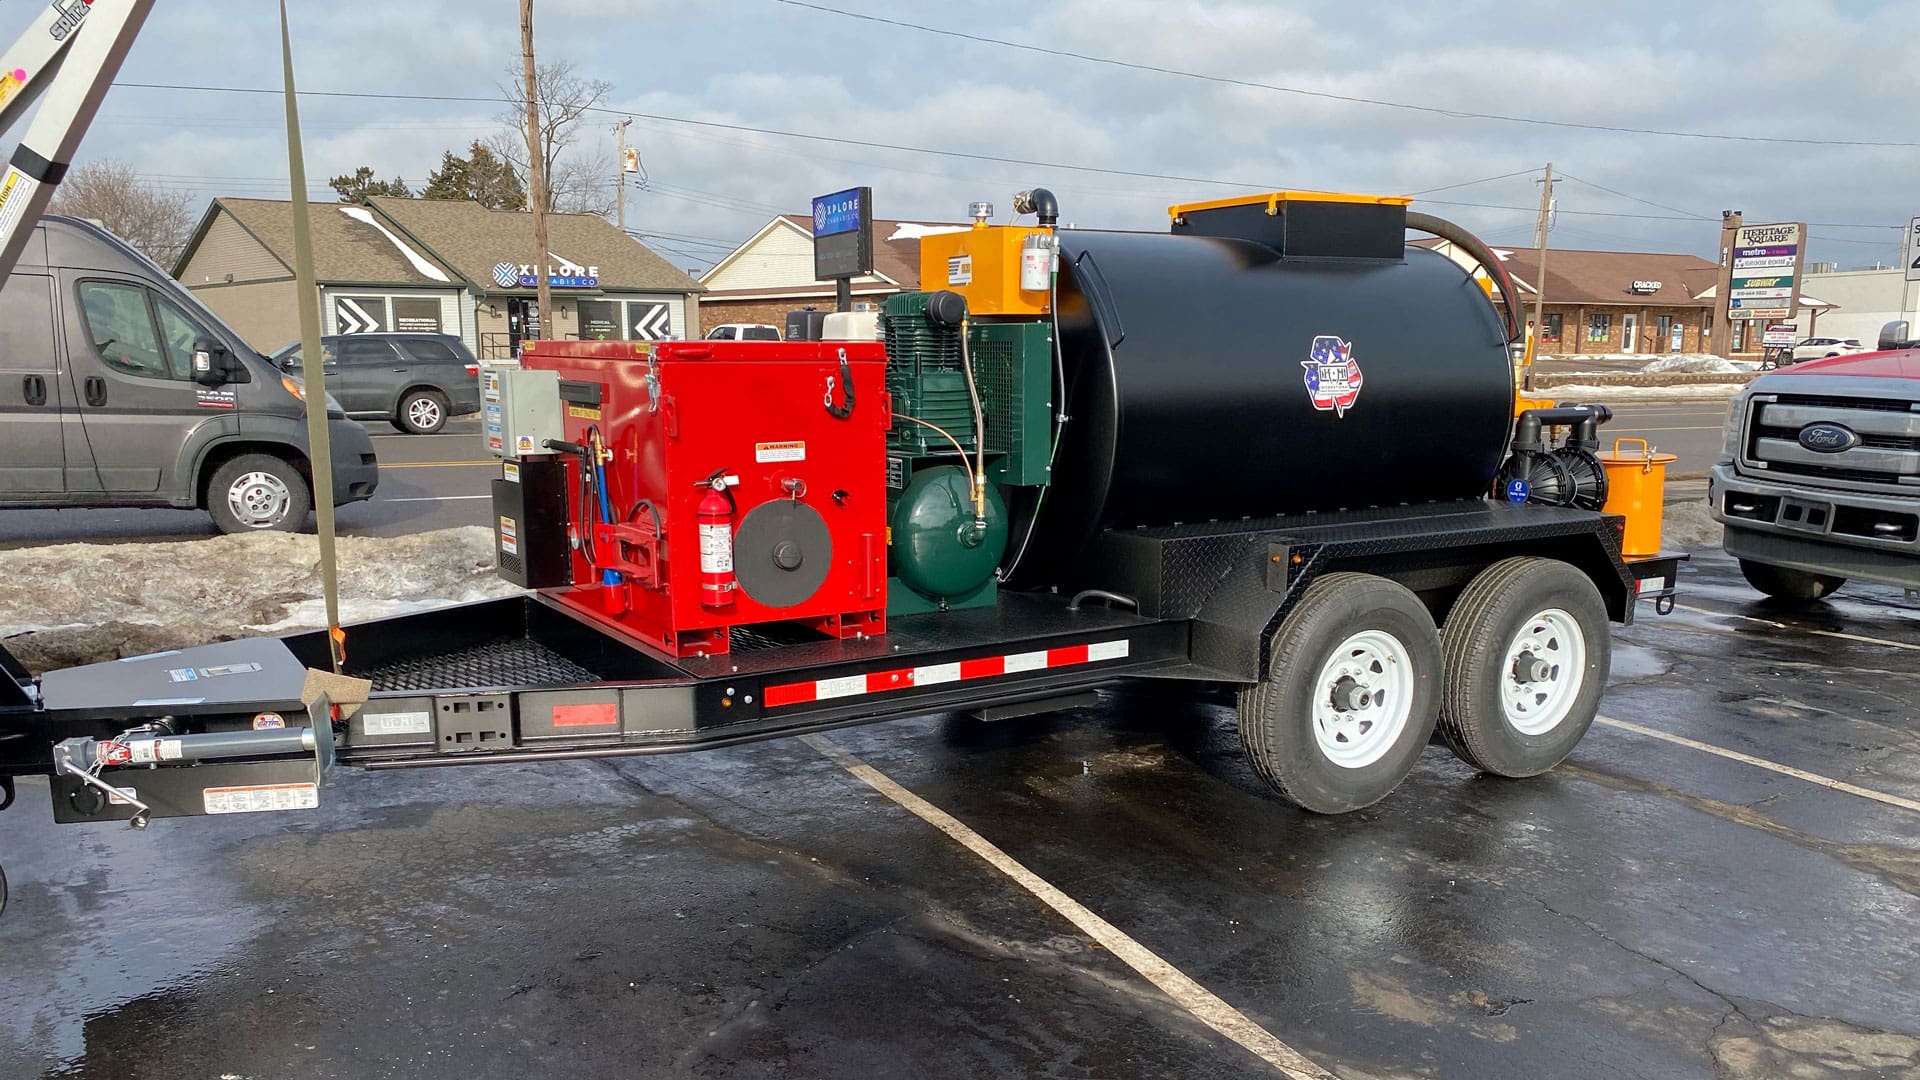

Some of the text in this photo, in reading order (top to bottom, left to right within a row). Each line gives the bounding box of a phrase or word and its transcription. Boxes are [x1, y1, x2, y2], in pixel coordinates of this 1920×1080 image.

[827, 199, 859, 215] XPLORE
[1743, 226, 1795, 240] HERITAGE
[1747, 234, 1788, 246] SQUARE
[1742, 248, 1767, 256] metro
[1744, 278, 1781, 288] SUBWAY
[1808, 428, 1839, 445] Ford
